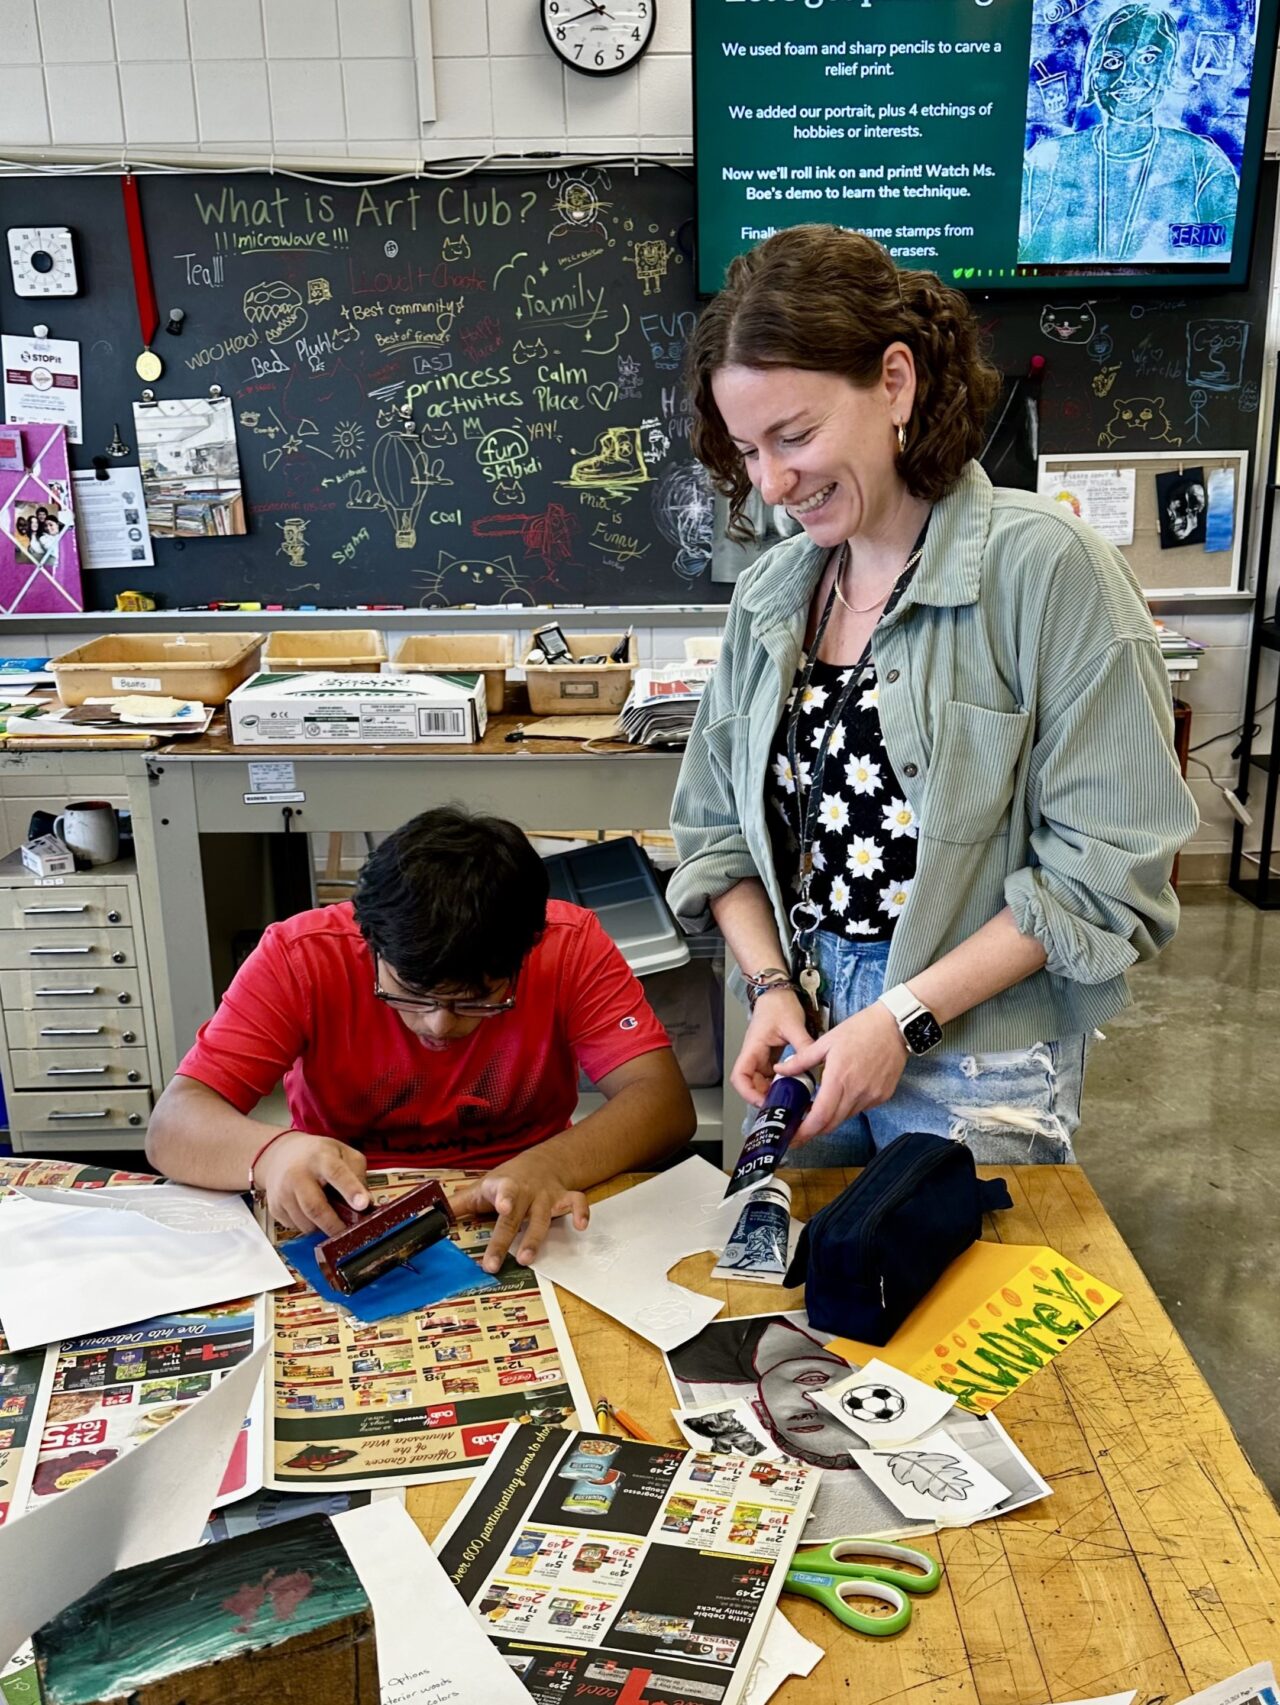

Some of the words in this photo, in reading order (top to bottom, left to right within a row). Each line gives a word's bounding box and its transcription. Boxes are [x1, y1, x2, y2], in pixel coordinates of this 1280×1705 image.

[549, 1, 560, 15] 9
[638, 2, 648, 19] 3
[556, 26, 567, 41] 8
[631, 26, 641, 41] 4
[573, 44, 584, 60] 7
[615, 44, 625, 60] 5
[721, 42, 747, 57] We
[749, 42, 782, 56] used
[783, 41, 818, 56] foam
[821, 41, 846, 55] and
[849, 40, 887, 57] sharp
[888, 39, 936, 57] pencils
[938, 40, 952, 54] to
[954, 42, 991, 54] carve
[993, 42, 1002, 53] a
[594, 49, 604, 66] 6
[825, 61, 859, 77] relief
[860, 61, 895, 79] print.
[728, 105, 753, 119] We
[755, 104, 797, 119] added
[799, 107, 822, 118] our
[824, 103, 876, 121] portrait,
[878, 103, 906, 120] plus
[908, 103, 918, 117] 4
[920, 102, 976, 119] etchings
[978, 102, 994, 116] of
[793, 125, 845, 139] hobbies
[847, 127, 862, 138] or
[864, 124, 923, 138] interests.
[722, 167, 754, 180] Now
[756, 166, 788, 180] we'll
[790, 165, 813, 180] roll
[815, 165, 836, 179] ink
[838, 168, 856, 179] on
[858, 165, 884, 178] and
[887, 164, 923, 181] print!
[925, 164, 970, 178] Watch
[973, 163, 996, 177] Ms.
[746, 186, 783, 200] Boe's
[785, 186, 823, 200] demo
[824, 187, 840, 199] to
[842, 185, 876, 199] learn
[877, 185, 901, 198] the
[902, 184, 971, 200] technique.
[194, 187, 289, 228] What
[303, 191, 335, 224] is
[355, 187, 421, 231] Art
[438, 187, 537, 227] Club?
[741, 226, 780, 240] Finall
[895, 225, 942, 240] stamps
[943, 223, 974, 237] from
[1179, 226, 1220, 245] ERIN
[889, 246, 939, 257] erasers.
[521, 271, 605, 329] family
[352, 301, 384, 320] Best
[375, 331, 400, 347] Best
[401, 328, 413, 341] of
[414, 329, 452, 344] friends
[32, 353, 62, 364] STOPit
[537, 362, 588, 385] Calm
[404, 366, 512, 408] princess
[427, 391, 524, 418] activities
[533, 385, 585, 413] Place
[483, 437, 524, 461] fun
[612, 510, 623, 525] is
[773, 1107, 787, 1120] 5
[736, 1154, 774, 1178] BLICK
[79, 1332, 145, 1347] Delicious
[430, 1409, 455, 1418] Cub
[73, 1419, 103, 1430] for
[360, 1439, 391, 1449] Wild
[394, 1431, 455, 1444] Minnesota
[393, 1446, 411, 1454] the
[409, 1449, 457, 1464] Official
[414, 1444, 427, 1454] of
[364, 1456, 407, 1466] Grocer
[623, 1488, 664, 1500] Progresso
[462, 1538, 486, 1563] 600
[480, 1475, 527, 1544] participating
[514, 1451, 537, 1481] items
[693, 1610, 726, 1620] Debbie
[696, 1604, 724, 1613] Packs
[724, 1608, 755, 1618] Family
[725, 1614, 753, 1624] Little
[574, 1682, 619, 1698] each
